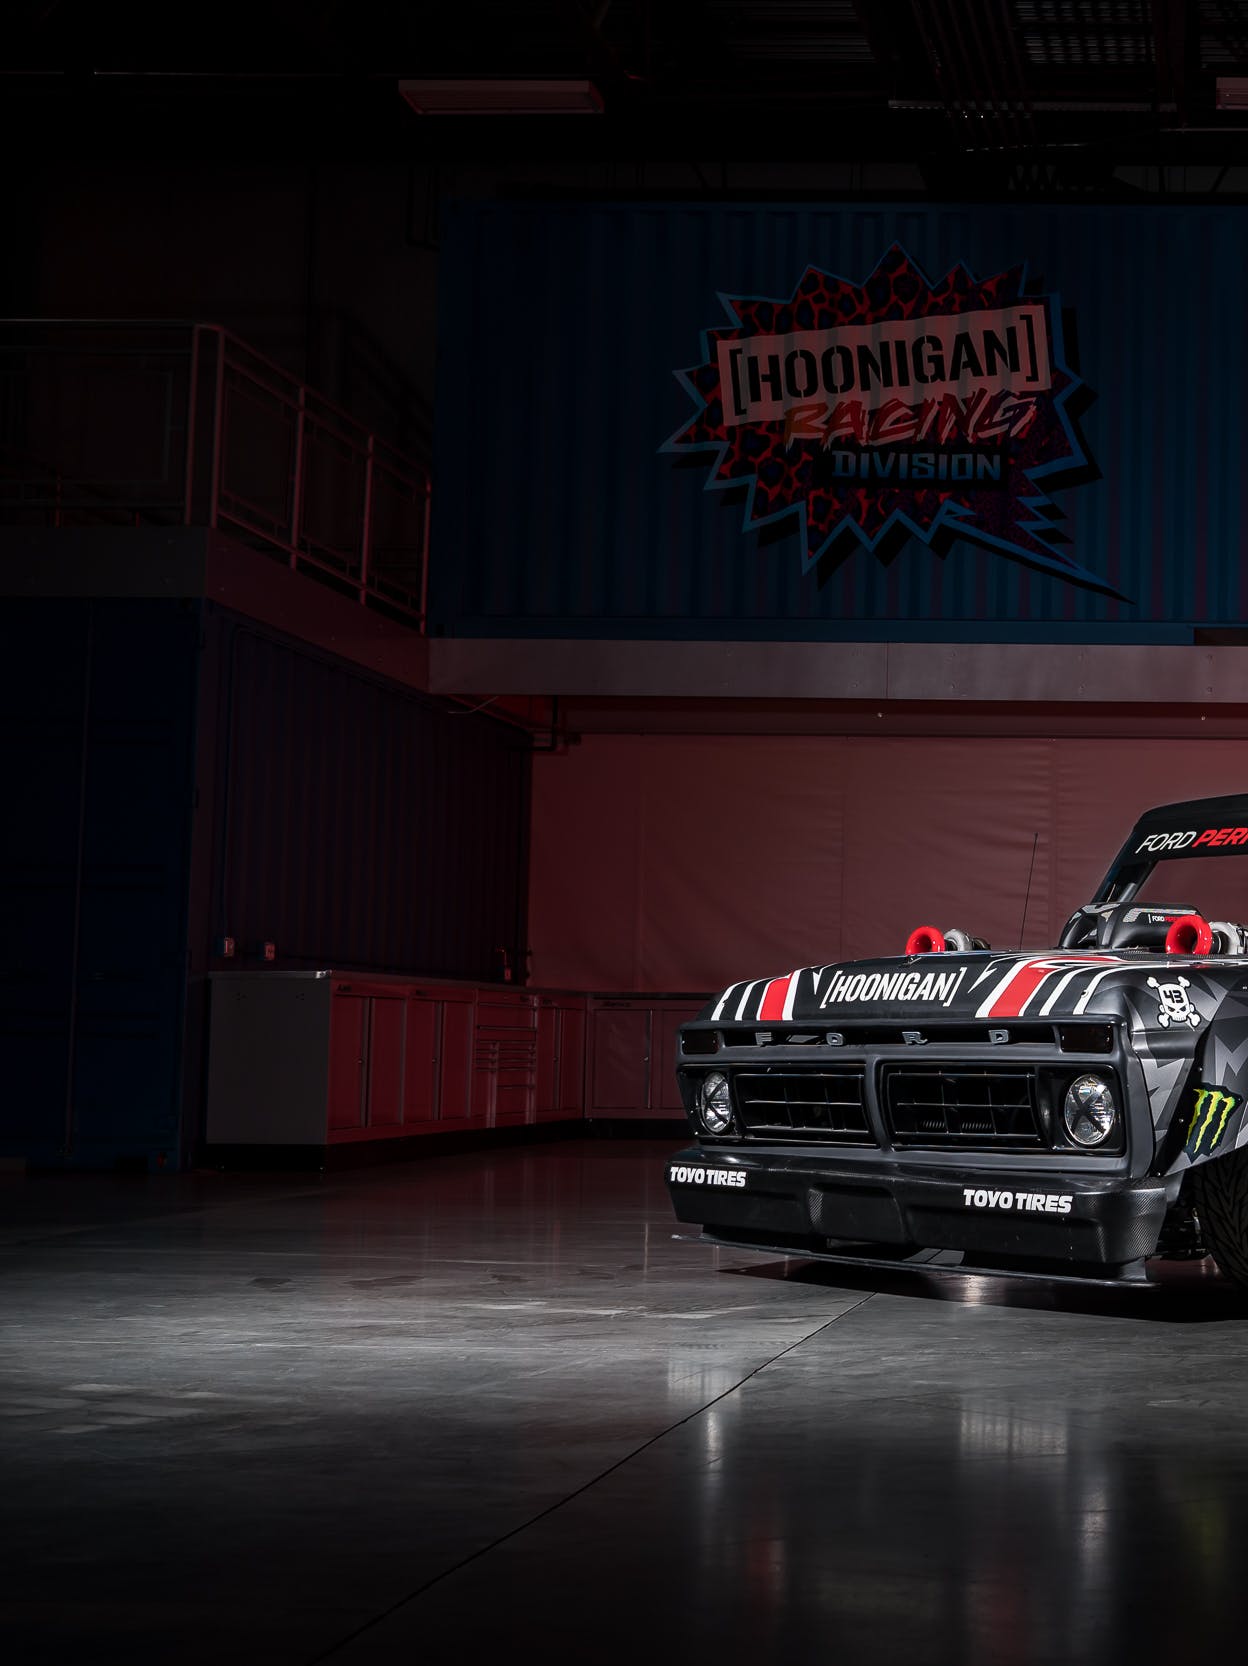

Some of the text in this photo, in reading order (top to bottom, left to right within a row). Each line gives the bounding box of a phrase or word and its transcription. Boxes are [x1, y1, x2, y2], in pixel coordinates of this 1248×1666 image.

[783, 388, 1038, 453] RACING
[831, 449, 1001, 481] DIVISION
[1135, 831, 1197, 853] FORD
[1163, 990, 1184, 1004] 43
[670, 1166, 747, 1188] TOYO TIRES
[963, 1188, 1073, 1214] TOYO TIRES
